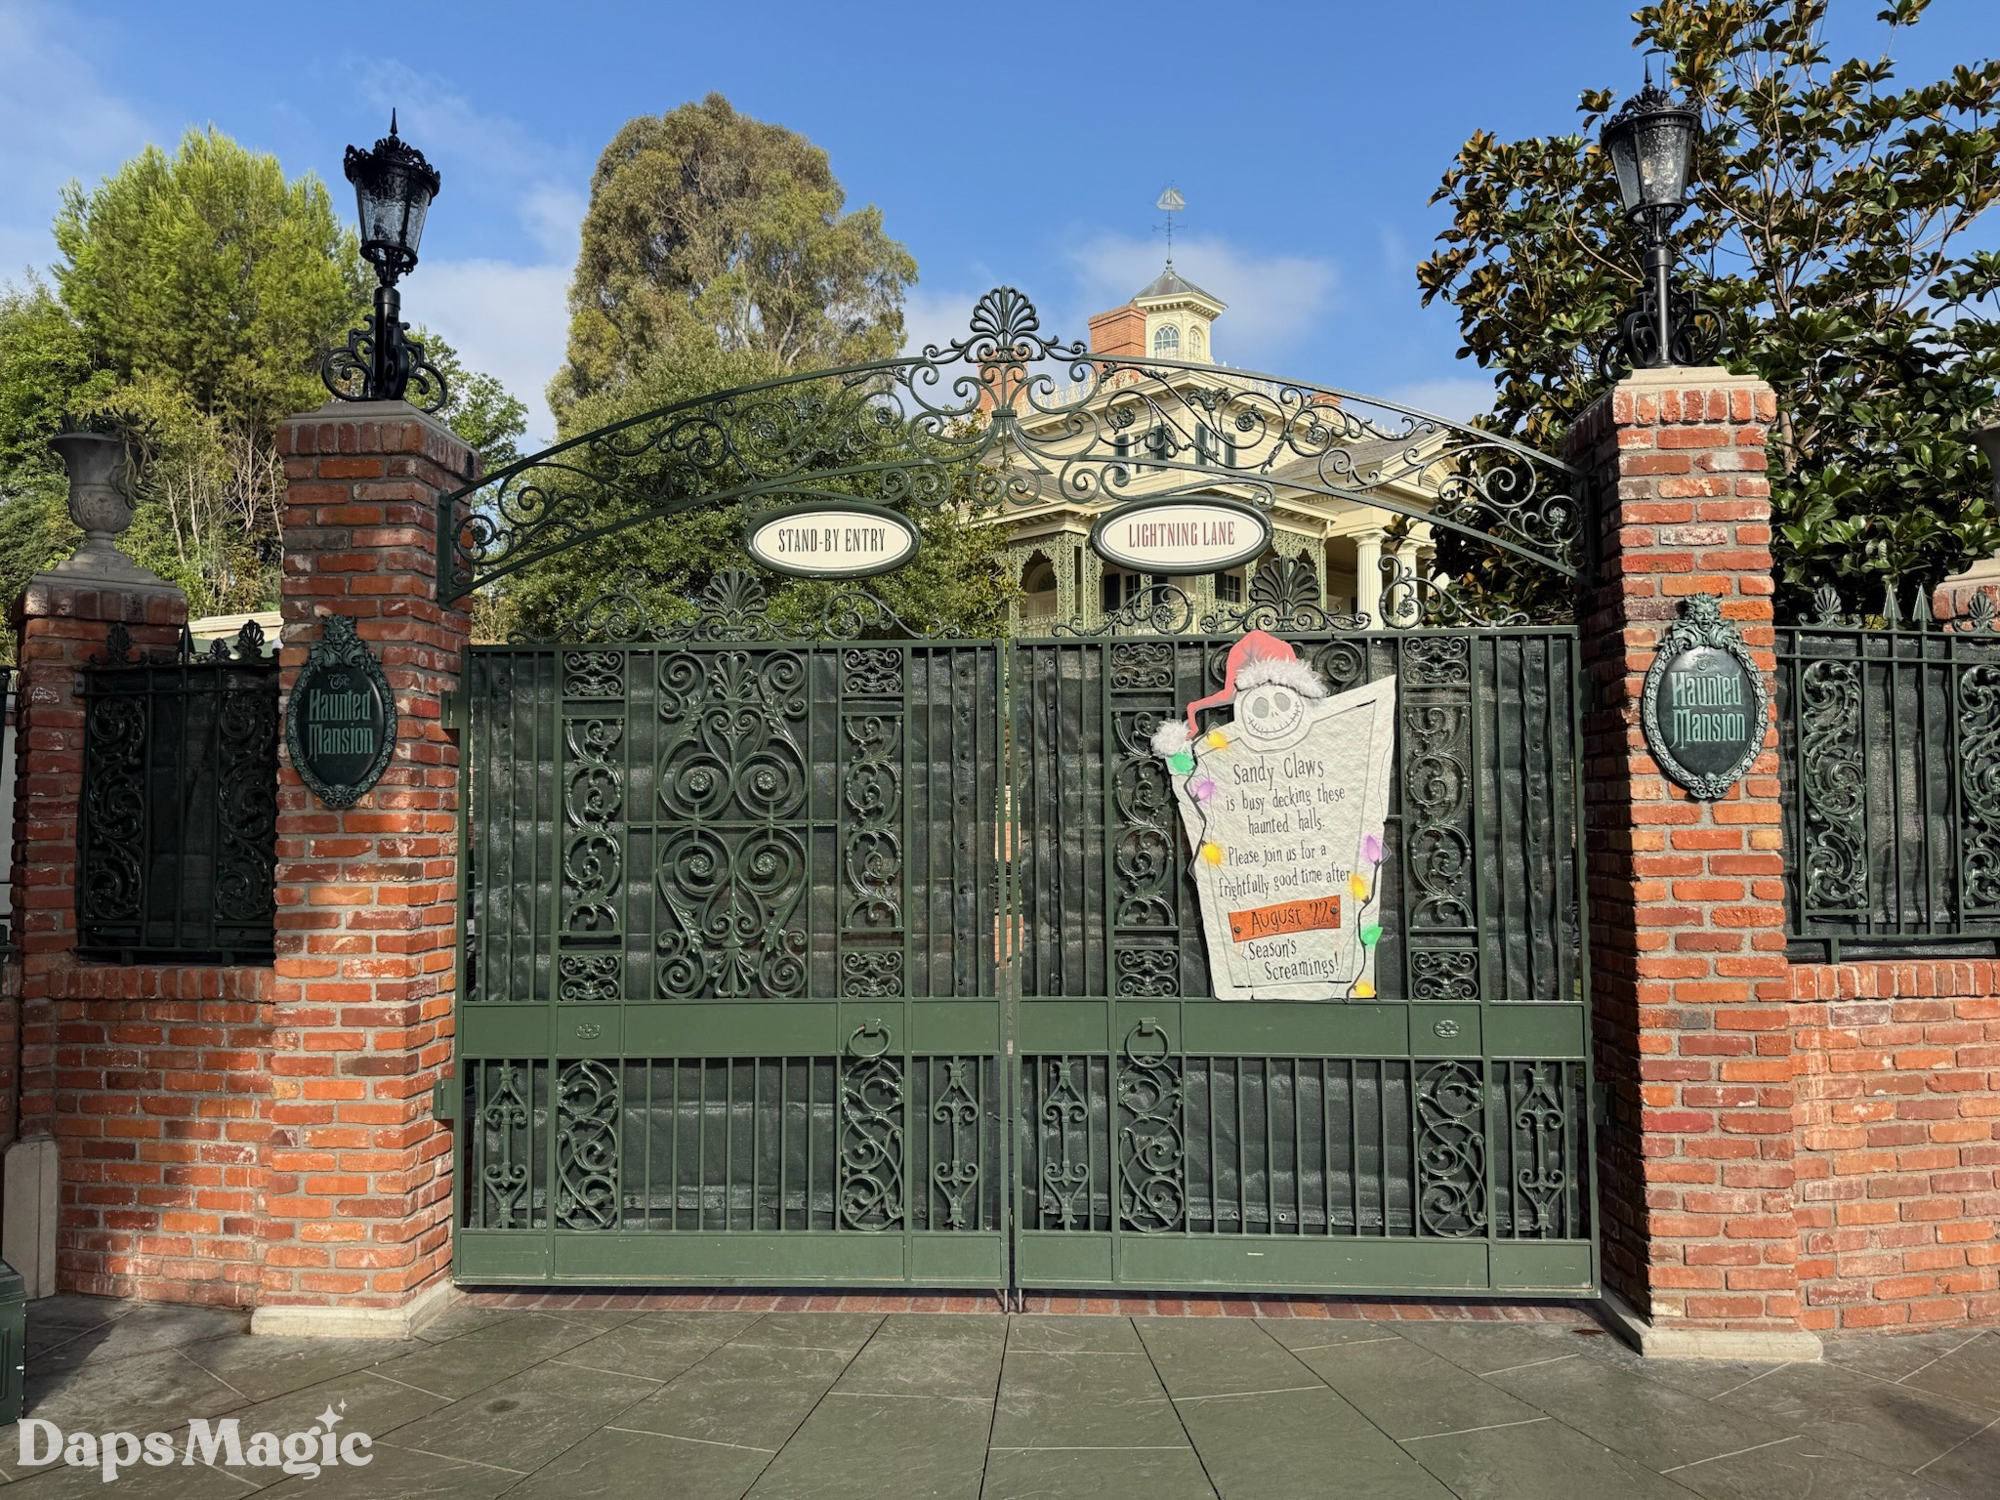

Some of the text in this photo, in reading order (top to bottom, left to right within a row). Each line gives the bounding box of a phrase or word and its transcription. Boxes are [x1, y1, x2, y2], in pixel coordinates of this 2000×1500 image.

[778, 528, 886, 552] STAND-BY ENTRY
[1129, 521, 1235, 547] LIGHTNING LANE
[1670, 669, 1743, 706] Haunted
[309, 688, 373, 721] Haunted
[307, 722, 374, 763] Mansion
[1669, 708, 1746, 749] Mansion
[1233, 752, 1324, 791] Sandy Claws
[1225, 782, 1346, 816] is busy decking these
[1247, 807, 1326, 837] haunted halls.
[1228, 840, 1327, 868] Please join us for a
[1219, 861, 1351, 901] frightfully good time after
[1251, 900, 1330, 935] August 22
[1248, 938, 1297, 961] Season's
[1264, 951, 1339, 980] Screamings!
